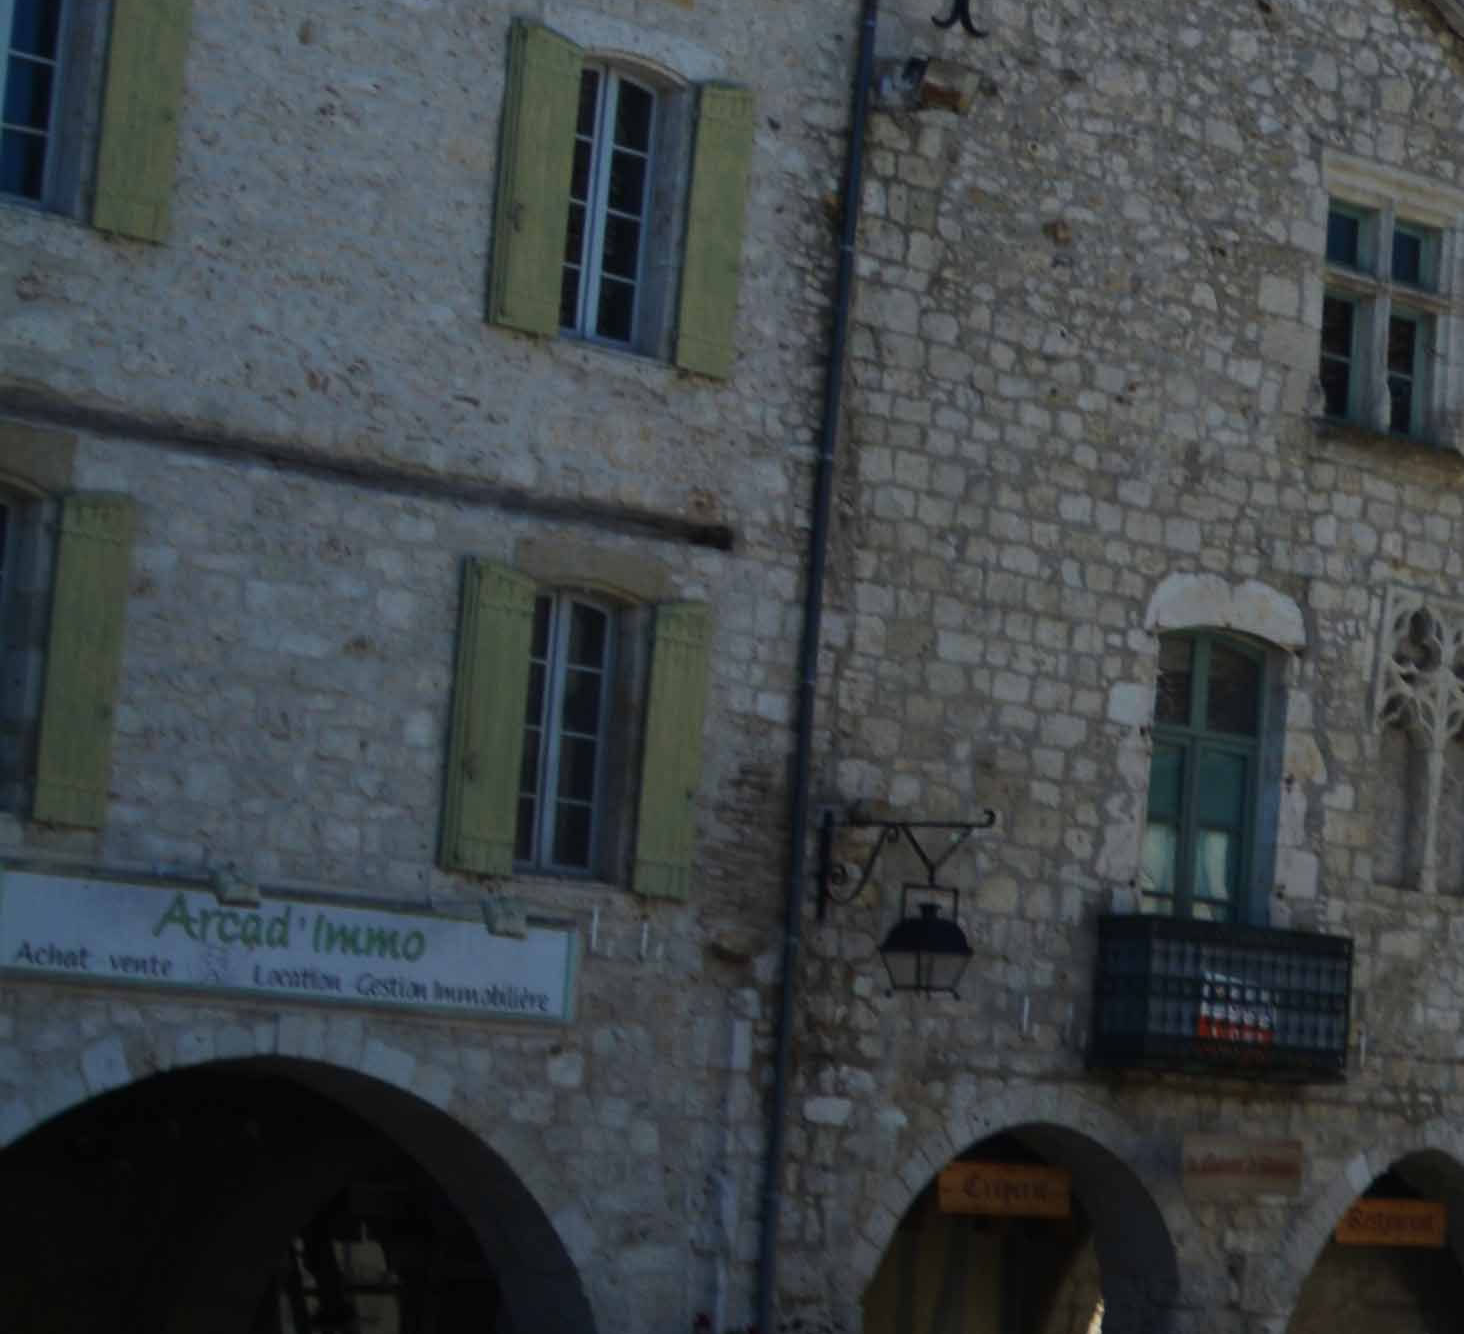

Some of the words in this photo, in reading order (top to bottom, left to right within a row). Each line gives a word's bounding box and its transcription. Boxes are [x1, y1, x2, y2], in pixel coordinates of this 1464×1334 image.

[16, 941, 90, 971] Achat
[109, 953, 174, 979] vente
[252, 964, 342, 993] Location
[354, 971, 430, 1001] Gestion
